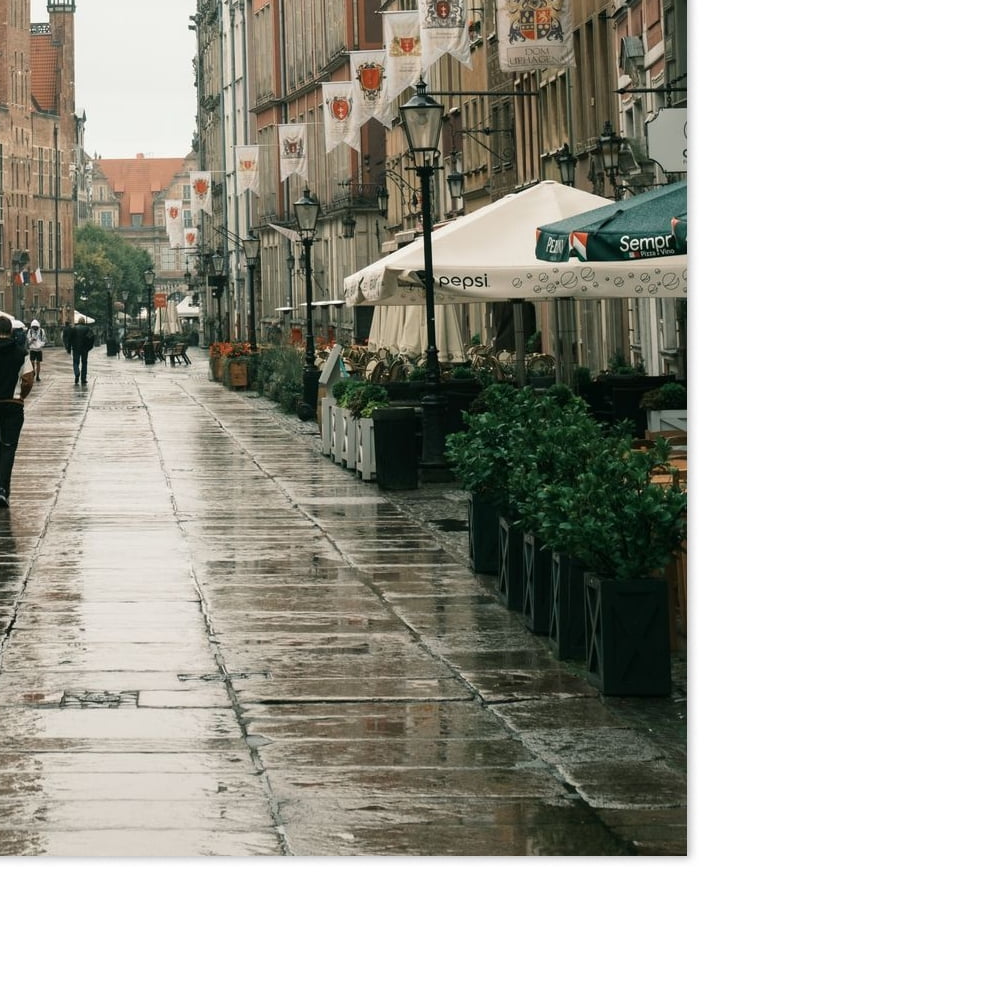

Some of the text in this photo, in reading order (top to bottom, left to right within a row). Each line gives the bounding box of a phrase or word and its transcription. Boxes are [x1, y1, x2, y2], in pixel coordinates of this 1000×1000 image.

[524, 47, 551, 56] DOM
[619, 234, 673, 252] Sempr
[659, 248, 675, 256] Vino
[438, 273, 489, 290] pepsi
